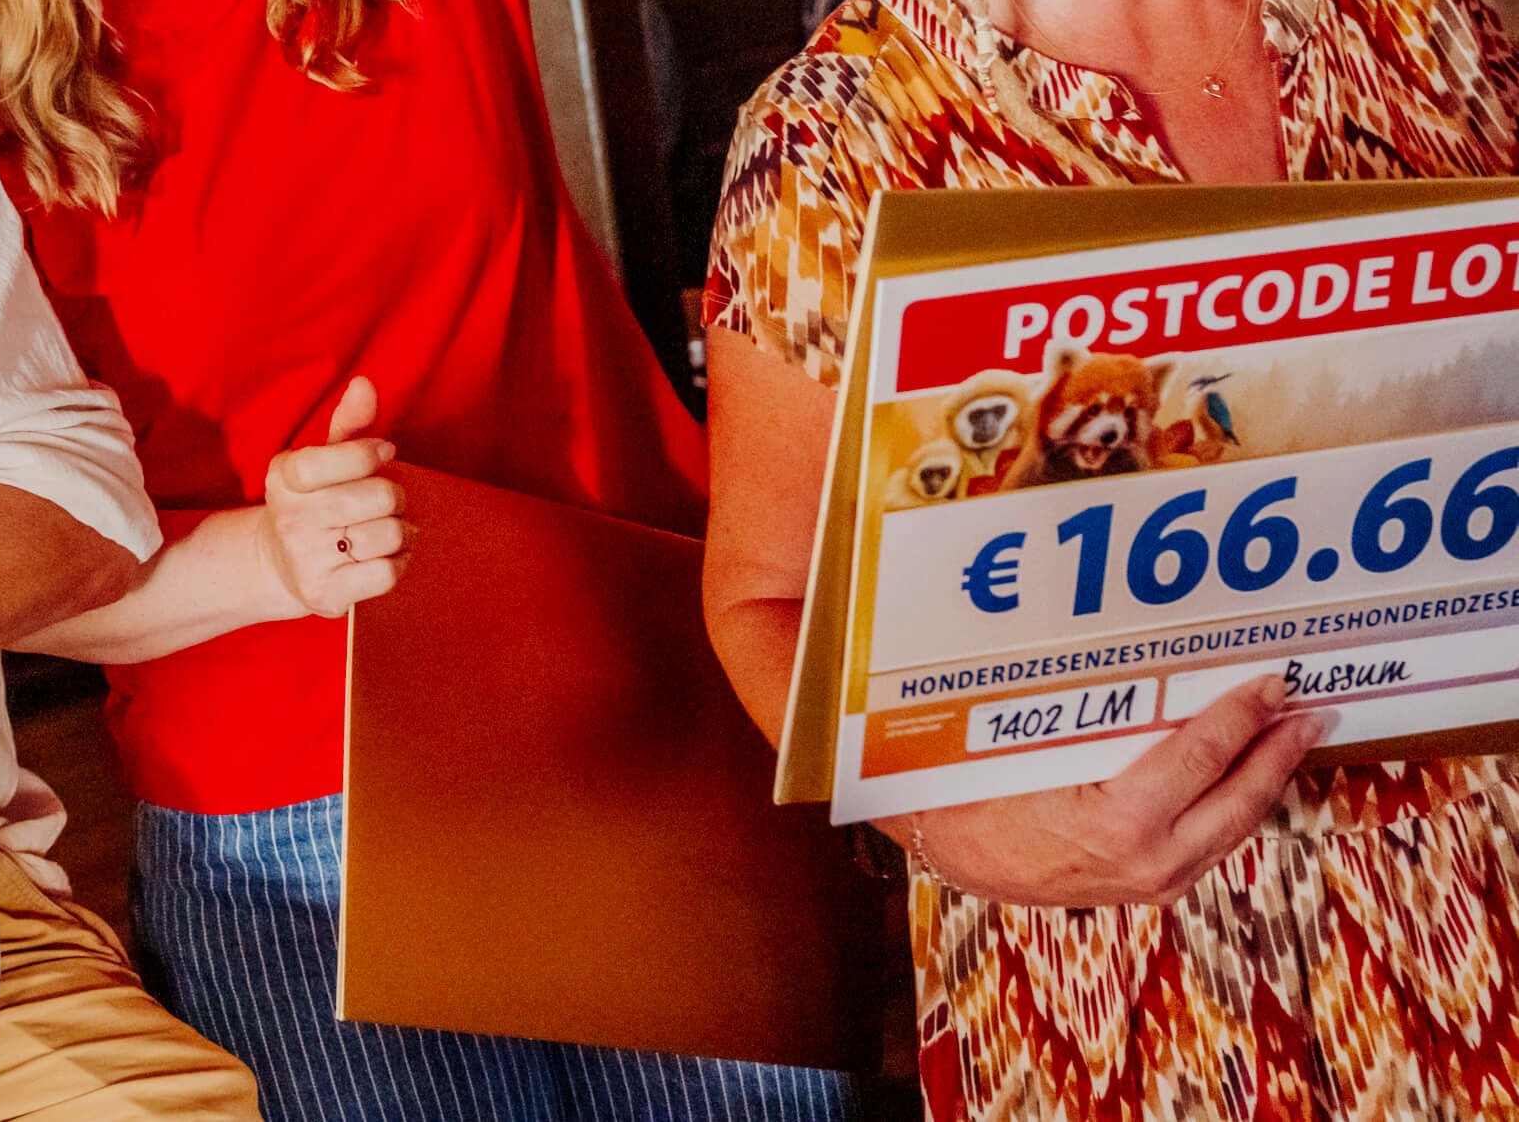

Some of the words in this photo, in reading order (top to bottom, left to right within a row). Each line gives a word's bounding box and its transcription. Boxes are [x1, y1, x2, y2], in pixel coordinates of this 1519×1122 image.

[1003, 256, 1394, 360] POSTCODE
[901, 619, 1298, 699] HONDERDZESENZESTIGDUIZEND
[1283, 660, 1413, 699] Bussum
[987, 704, 1063, 743] 1402
[1076, 684, 1137, 731] LM
